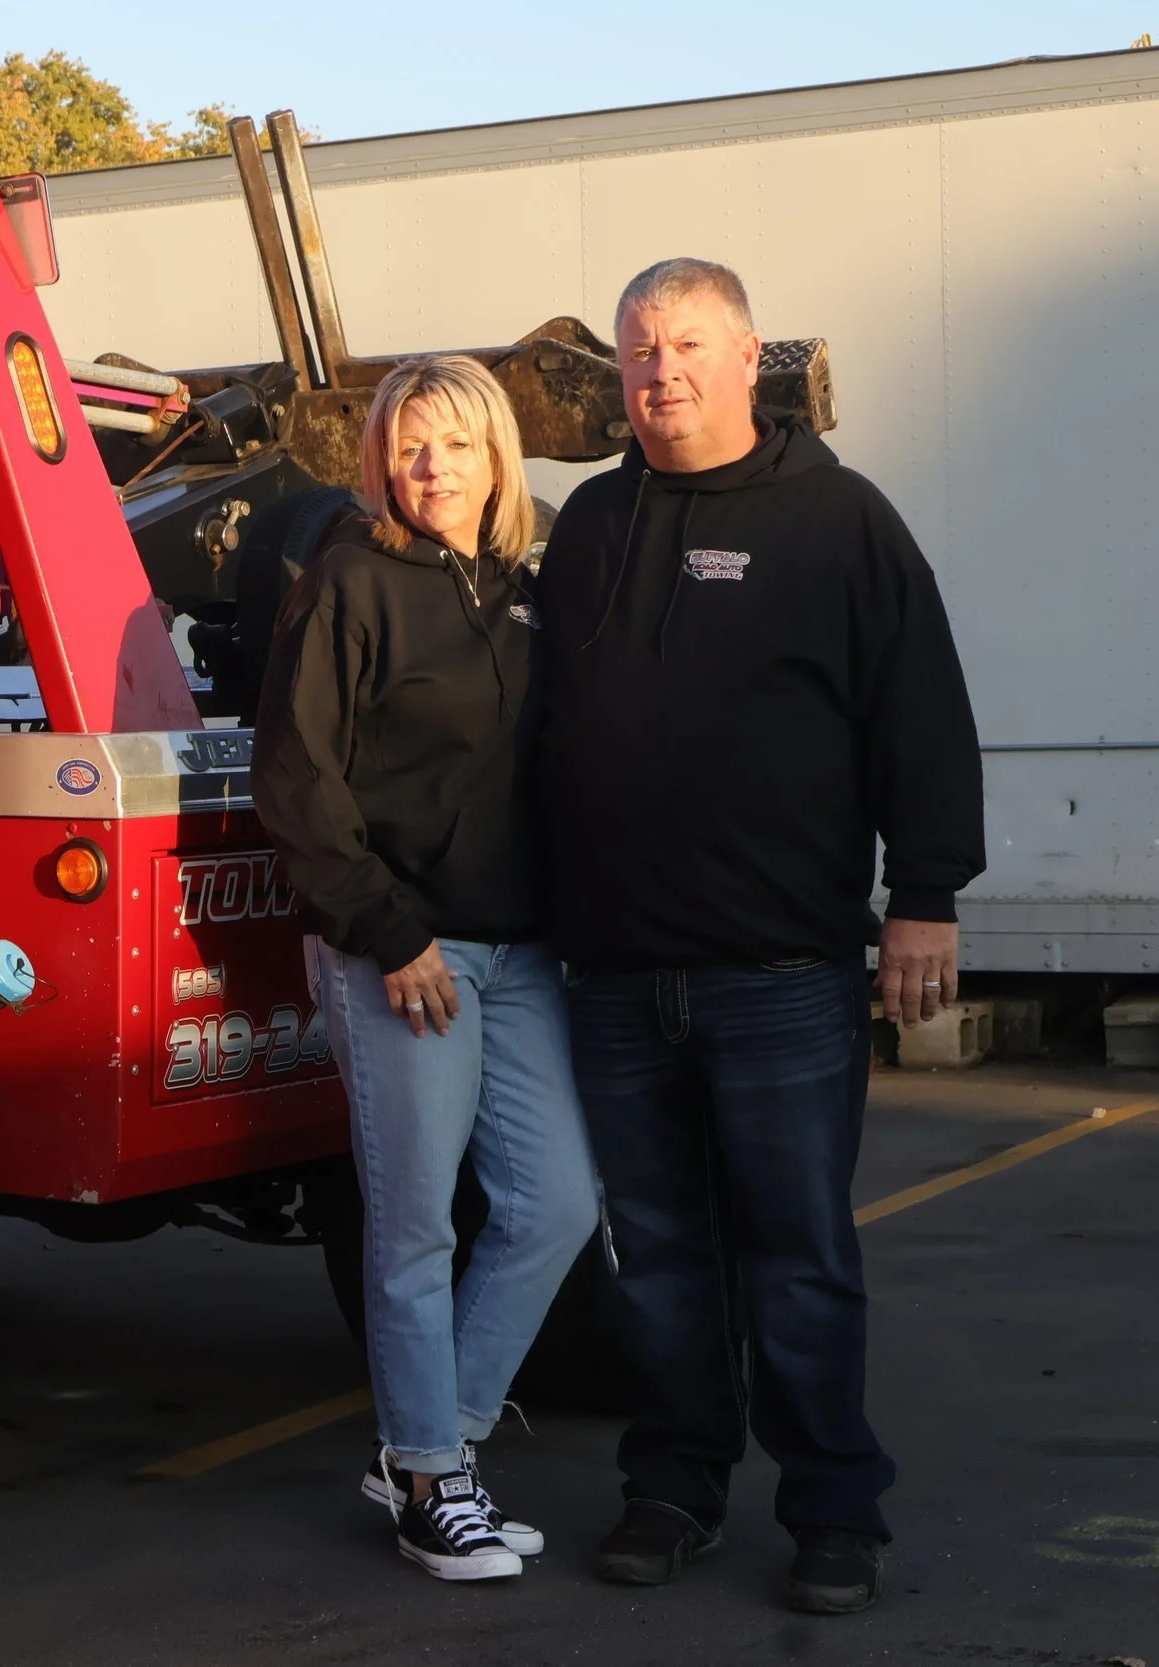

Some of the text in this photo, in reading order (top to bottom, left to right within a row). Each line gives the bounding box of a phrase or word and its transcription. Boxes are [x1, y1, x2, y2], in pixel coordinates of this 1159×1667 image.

[689, 551, 751, 565] BUFFALO
[692, 563, 744, 572] ROAD AUTO
[703, 571, 744, 580] TOWING
[179, 855, 298, 926] TOW
[173, 963, 226, 1004] (585)
[166, 1005, 335, 1087] 319-34
